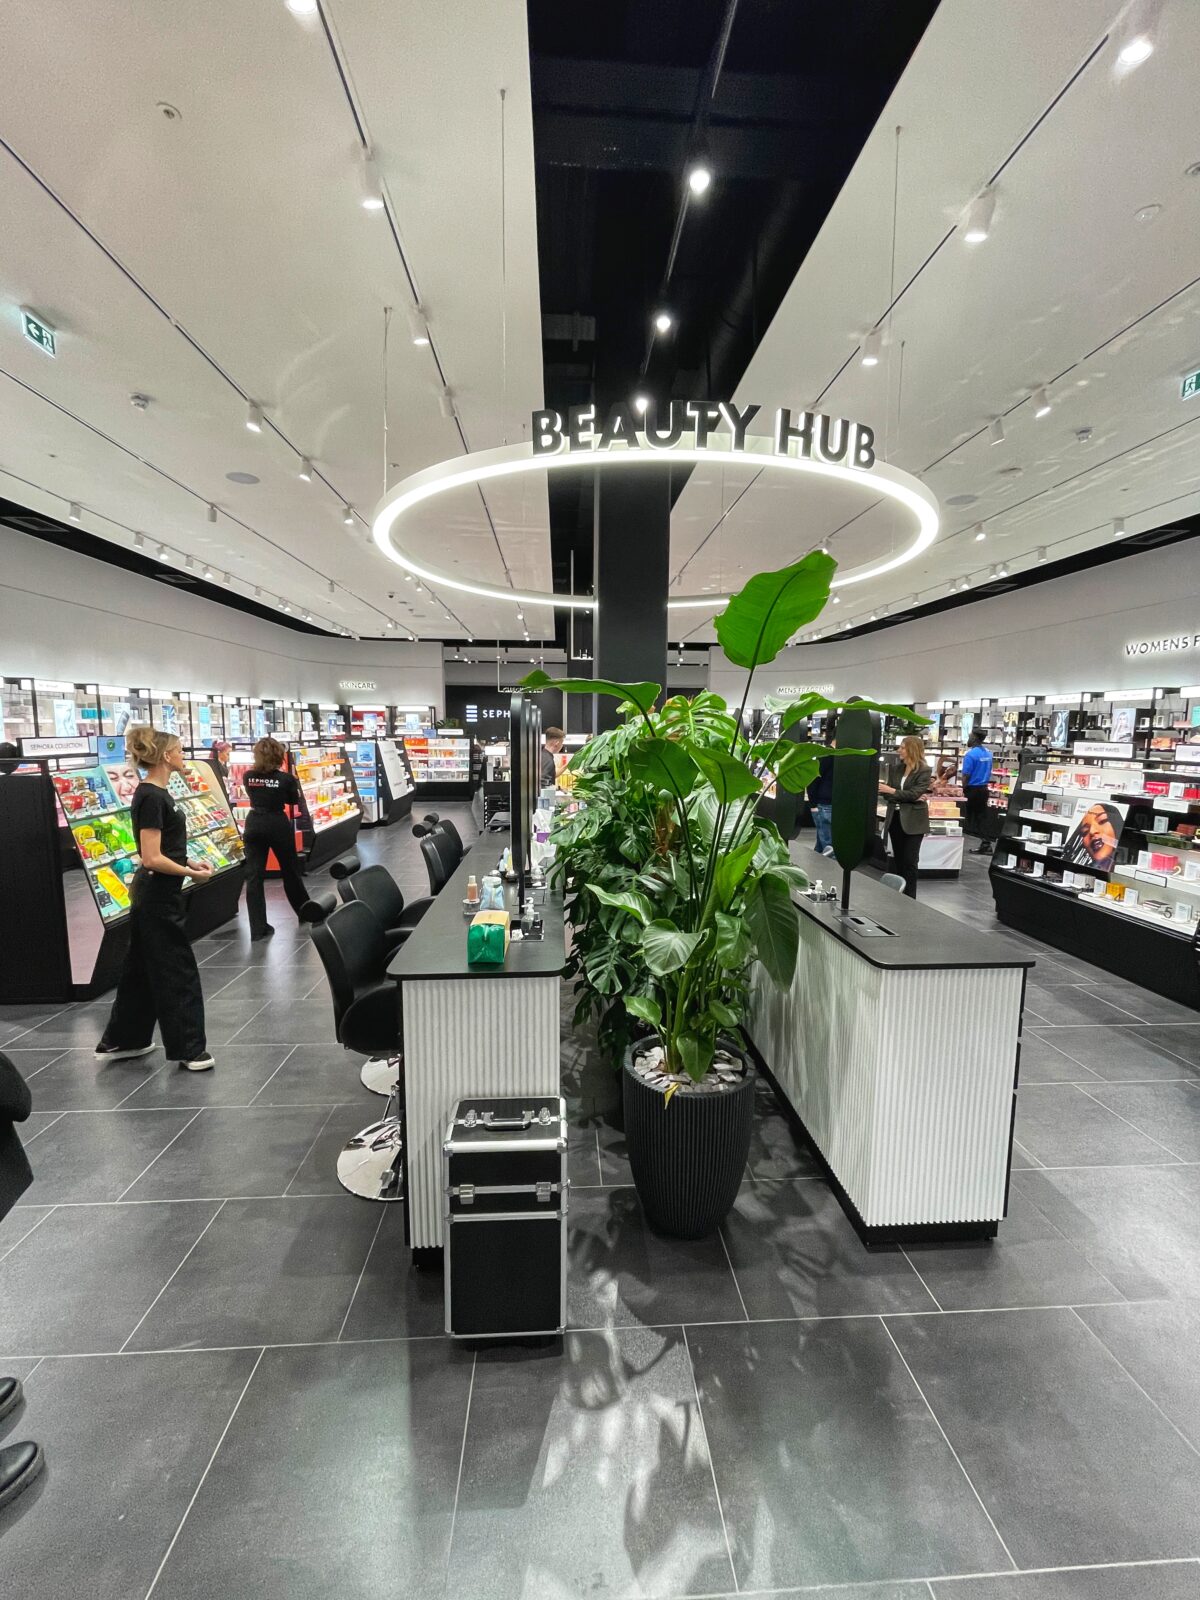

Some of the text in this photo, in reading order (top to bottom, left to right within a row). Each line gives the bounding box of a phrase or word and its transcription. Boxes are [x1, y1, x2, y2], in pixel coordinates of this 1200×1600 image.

[532, 399, 876, 471] BEAUTY HUB
[1125, 635, 1190, 656] WOMENS
[482, 709, 511, 718] SEPH
[30, 742, 83, 751] SEPHORA COLLECTION
